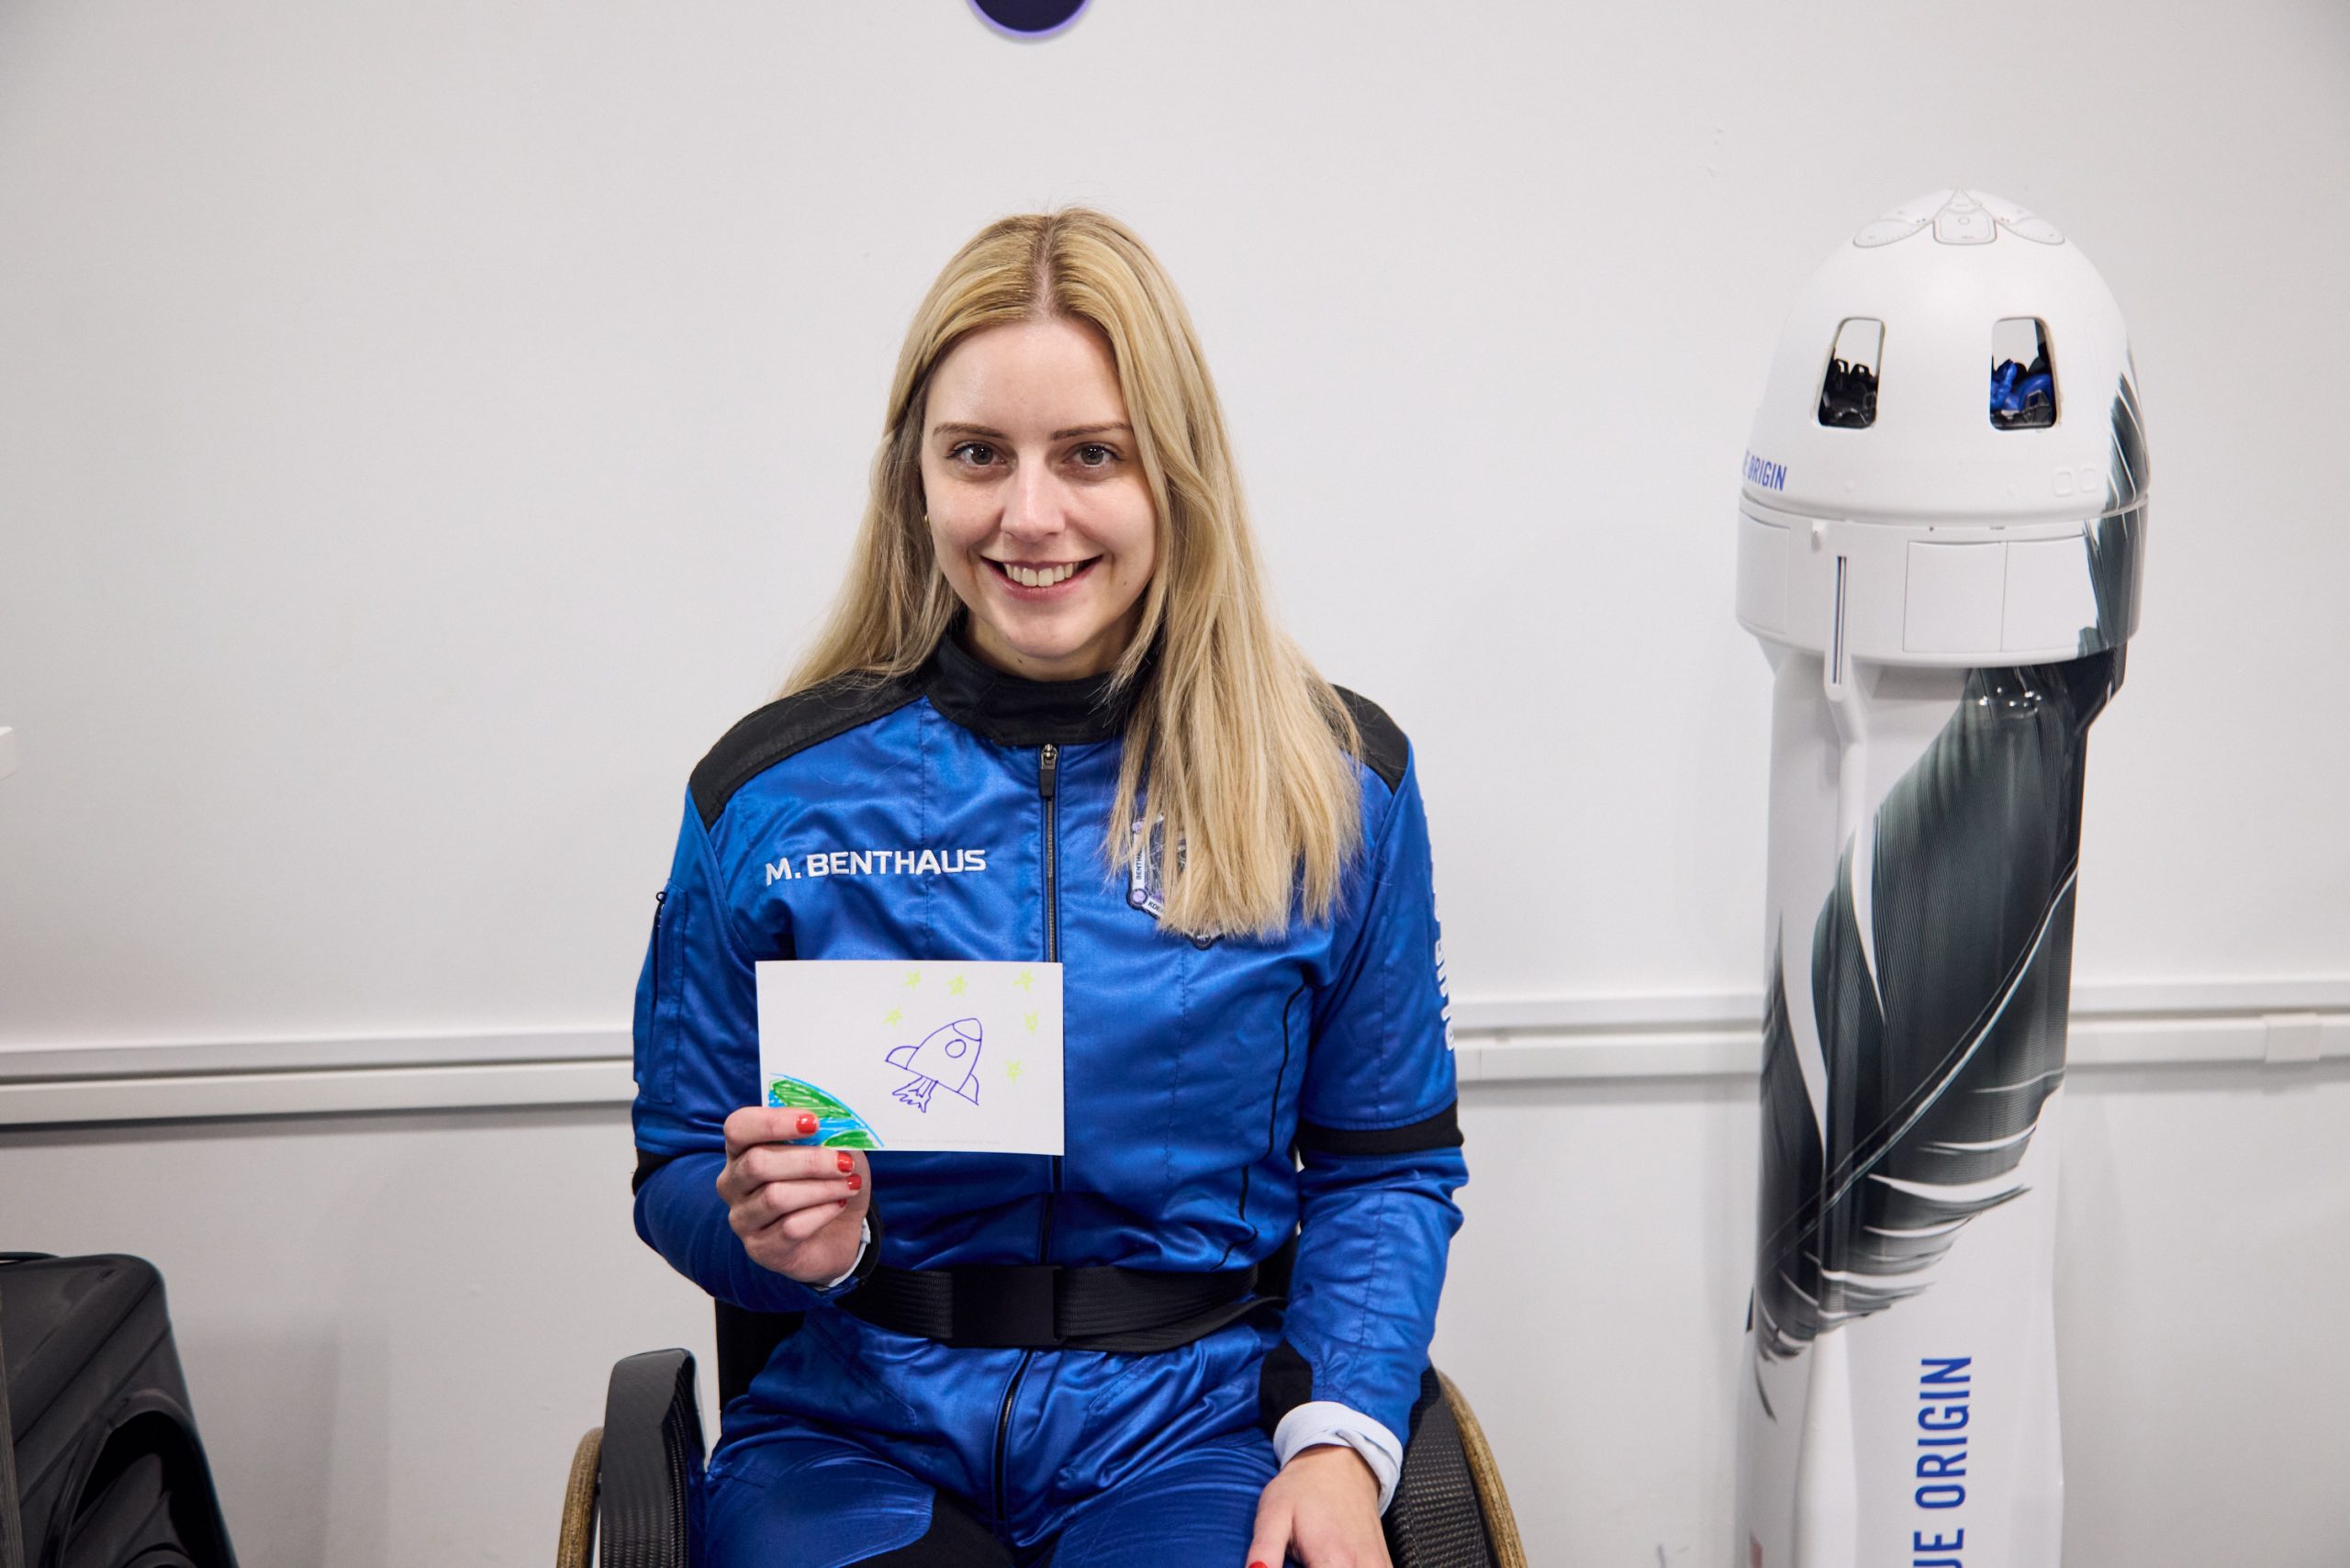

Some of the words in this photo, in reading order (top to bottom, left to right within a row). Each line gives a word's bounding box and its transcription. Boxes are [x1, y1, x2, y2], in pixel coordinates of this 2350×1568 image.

[1748, 455, 1787, 491] ORIGIN
[765, 857, 801, 887] M.
[806, 849, 987, 878] BENTHAUS
[1915, 1356, 1973, 1509] ORIGIN
